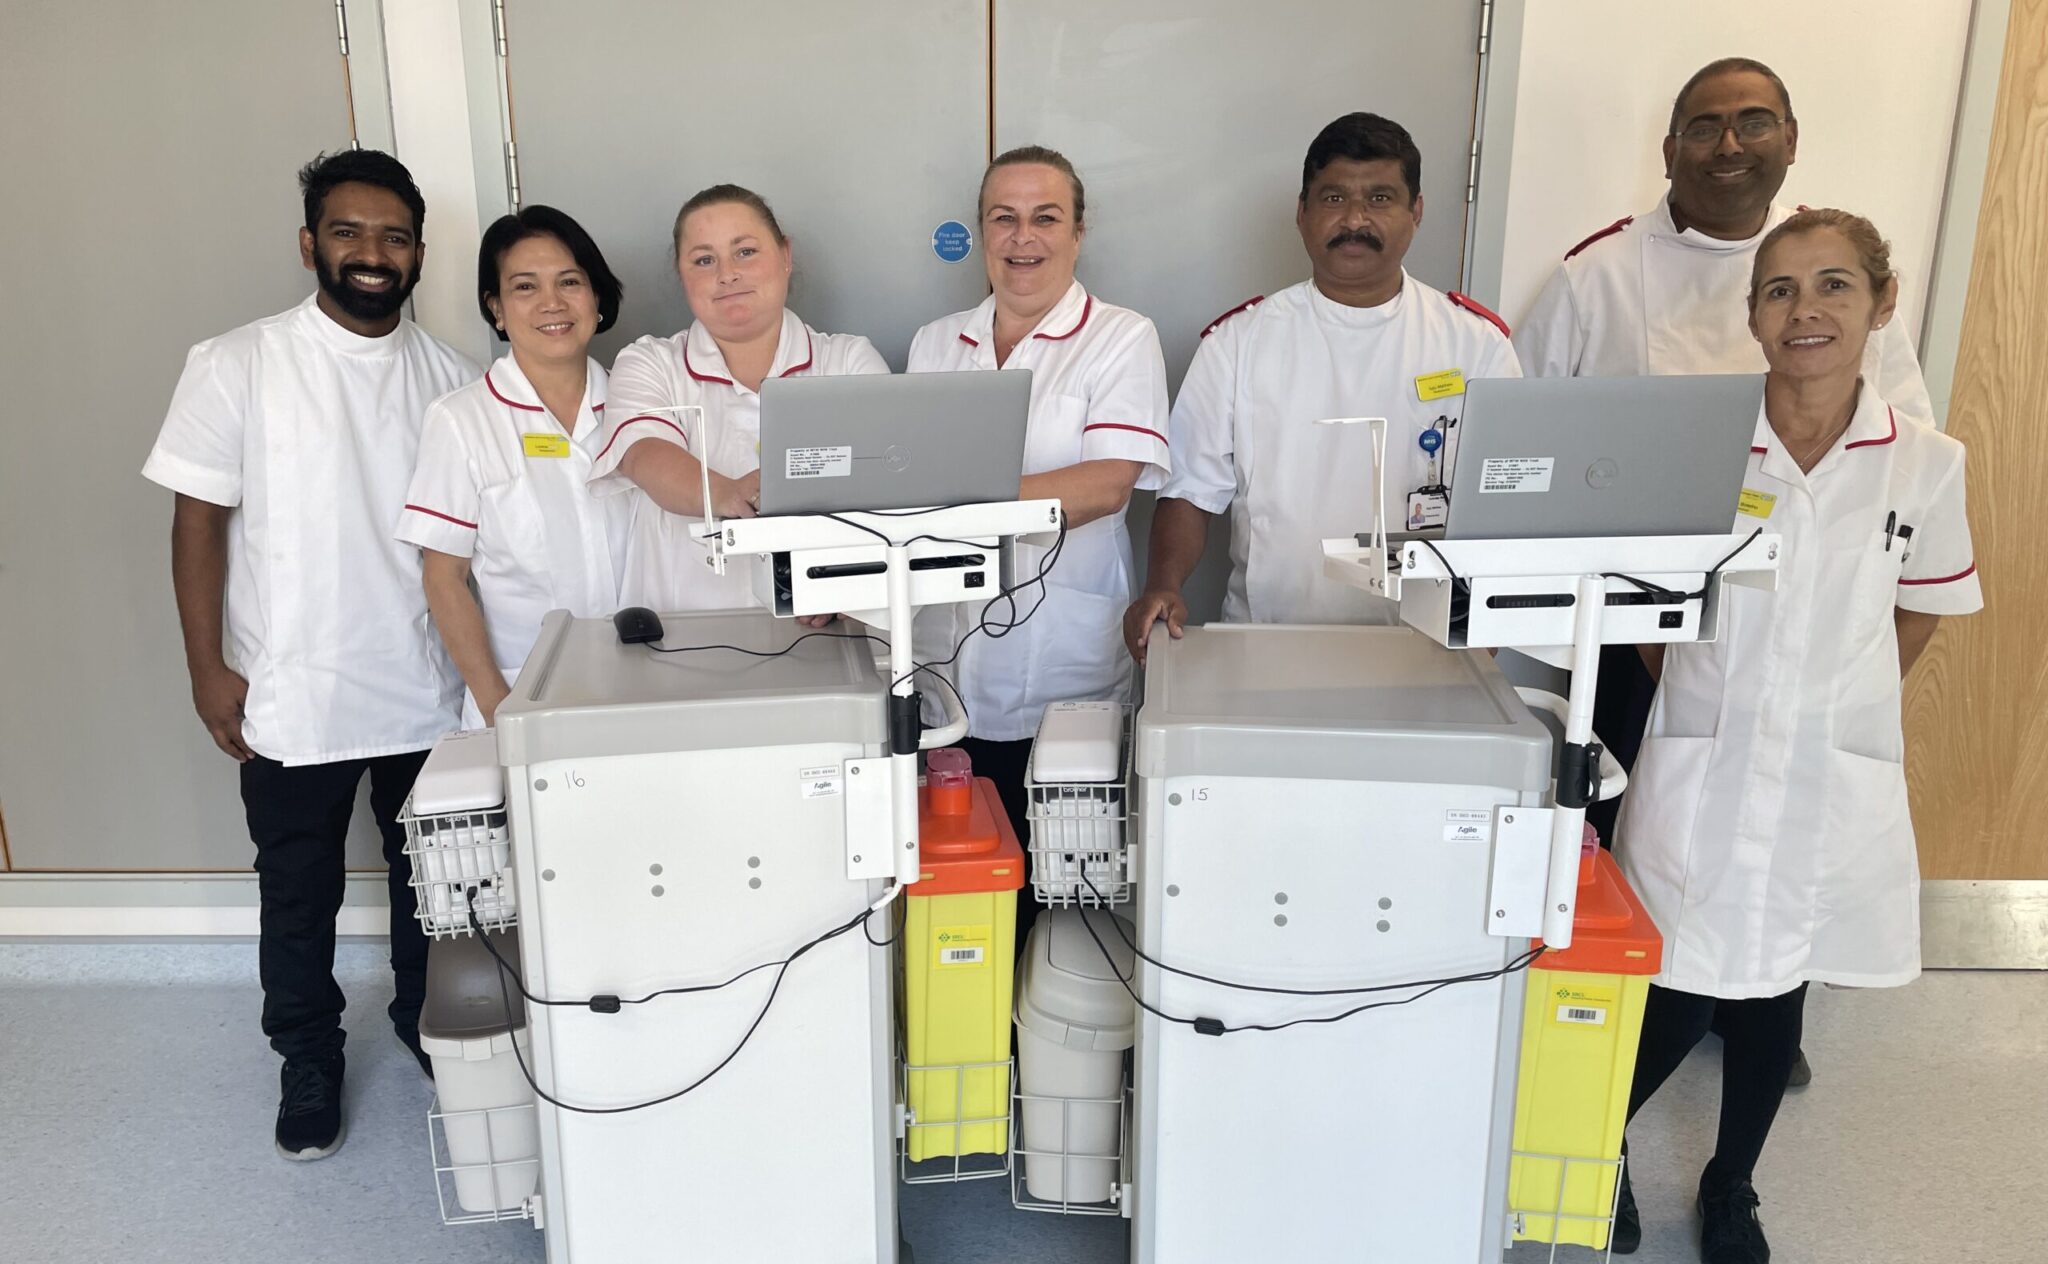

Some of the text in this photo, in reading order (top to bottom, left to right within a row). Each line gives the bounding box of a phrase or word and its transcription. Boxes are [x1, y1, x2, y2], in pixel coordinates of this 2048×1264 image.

[564, 769, 586, 790] 16
[814, 781, 832, 790] Agile
[1191, 787, 1208, 801] 15
[1457, 826, 1478, 834] Agile
